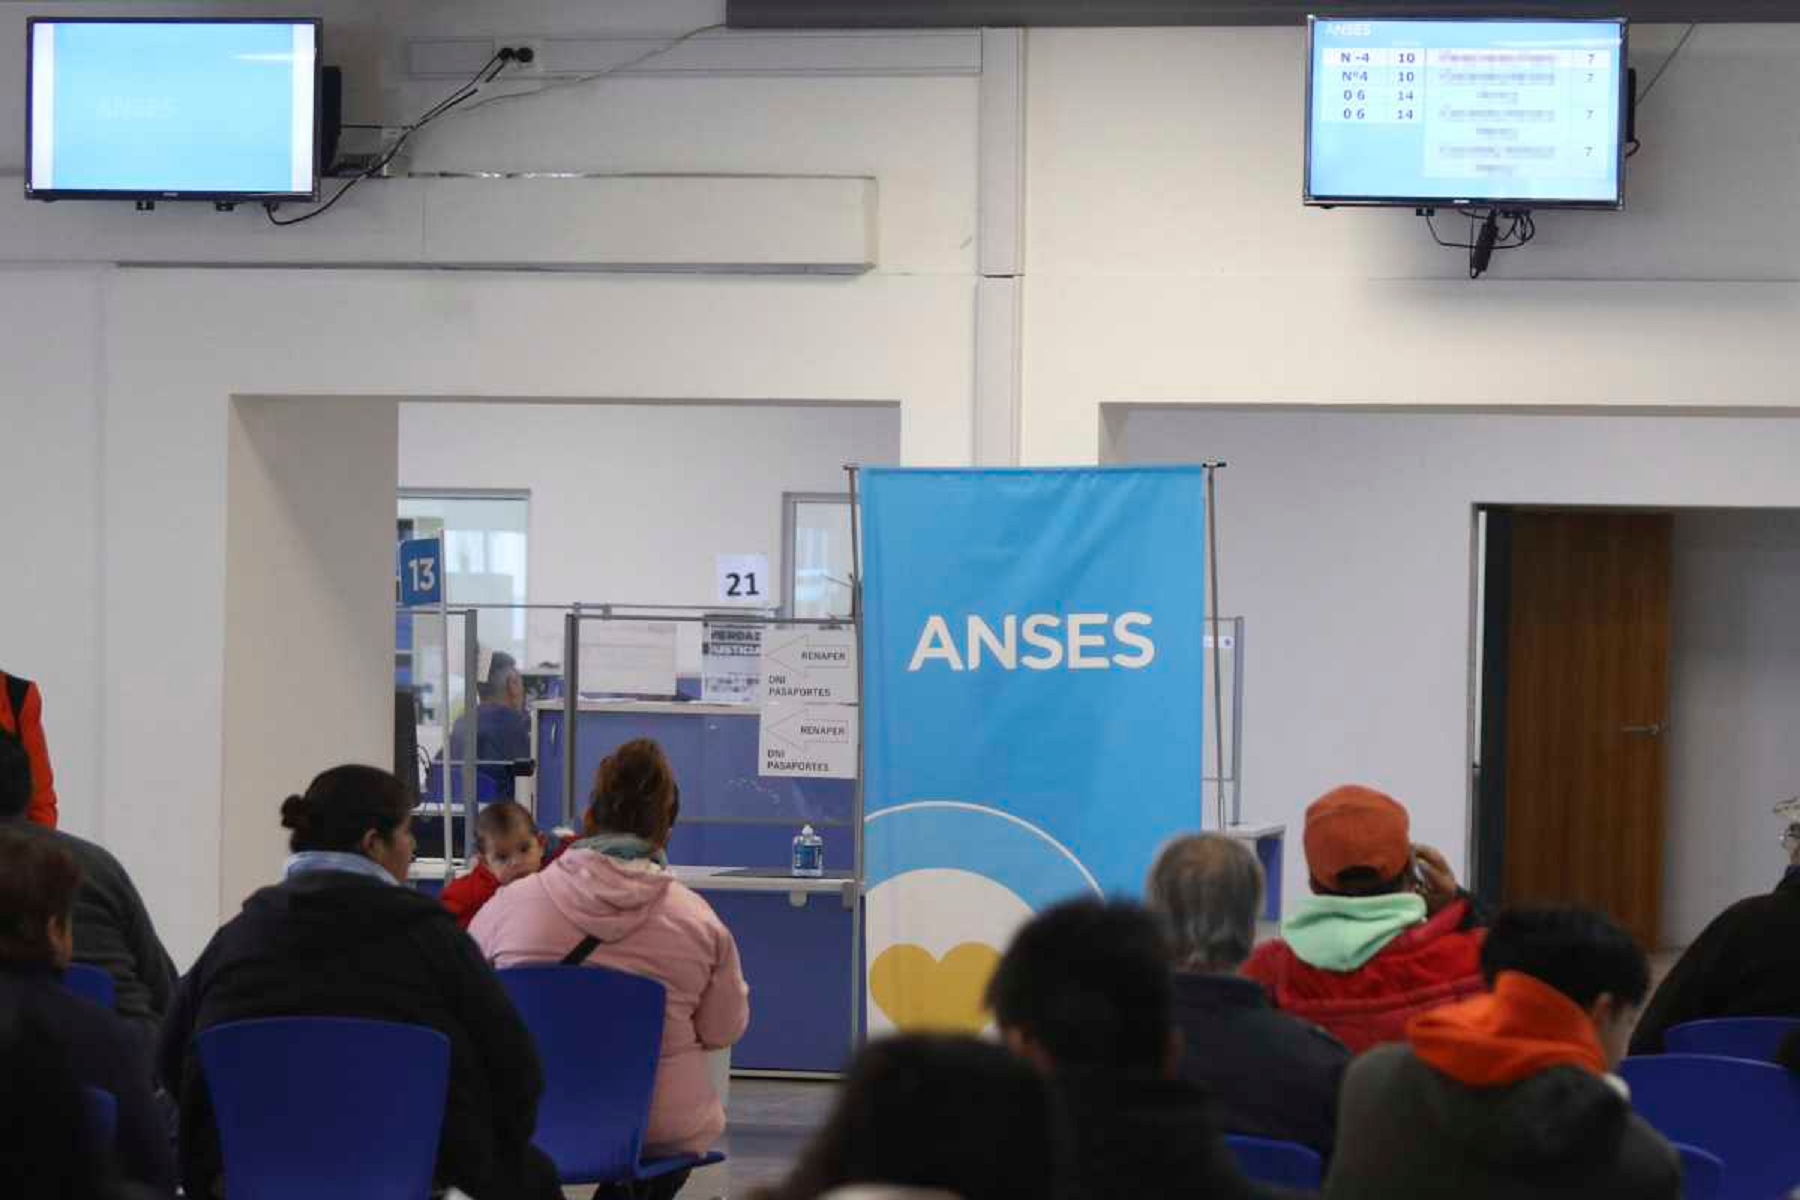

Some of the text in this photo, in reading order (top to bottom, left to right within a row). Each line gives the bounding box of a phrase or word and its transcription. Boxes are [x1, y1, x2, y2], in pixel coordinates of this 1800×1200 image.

[1398, 52, 1416, 63] 10
[1398, 71, 1415, 82] 10
[1397, 90, 1414, 101] 14
[1397, 109, 1414, 119] 14
[408, 557, 435, 591] 13
[726, 572, 759, 596] 21
[907, 611, 1156, 671] ANSES
[801, 651, 846, 661] RENAPER
[768, 675, 786, 684] DNI
[768, 687, 831, 697] PASAPORTES
[800, 725, 845, 736] RENAPER
[767, 749, 785, 758] DNI
[767, 761, 829, 772] PASAPORTES
